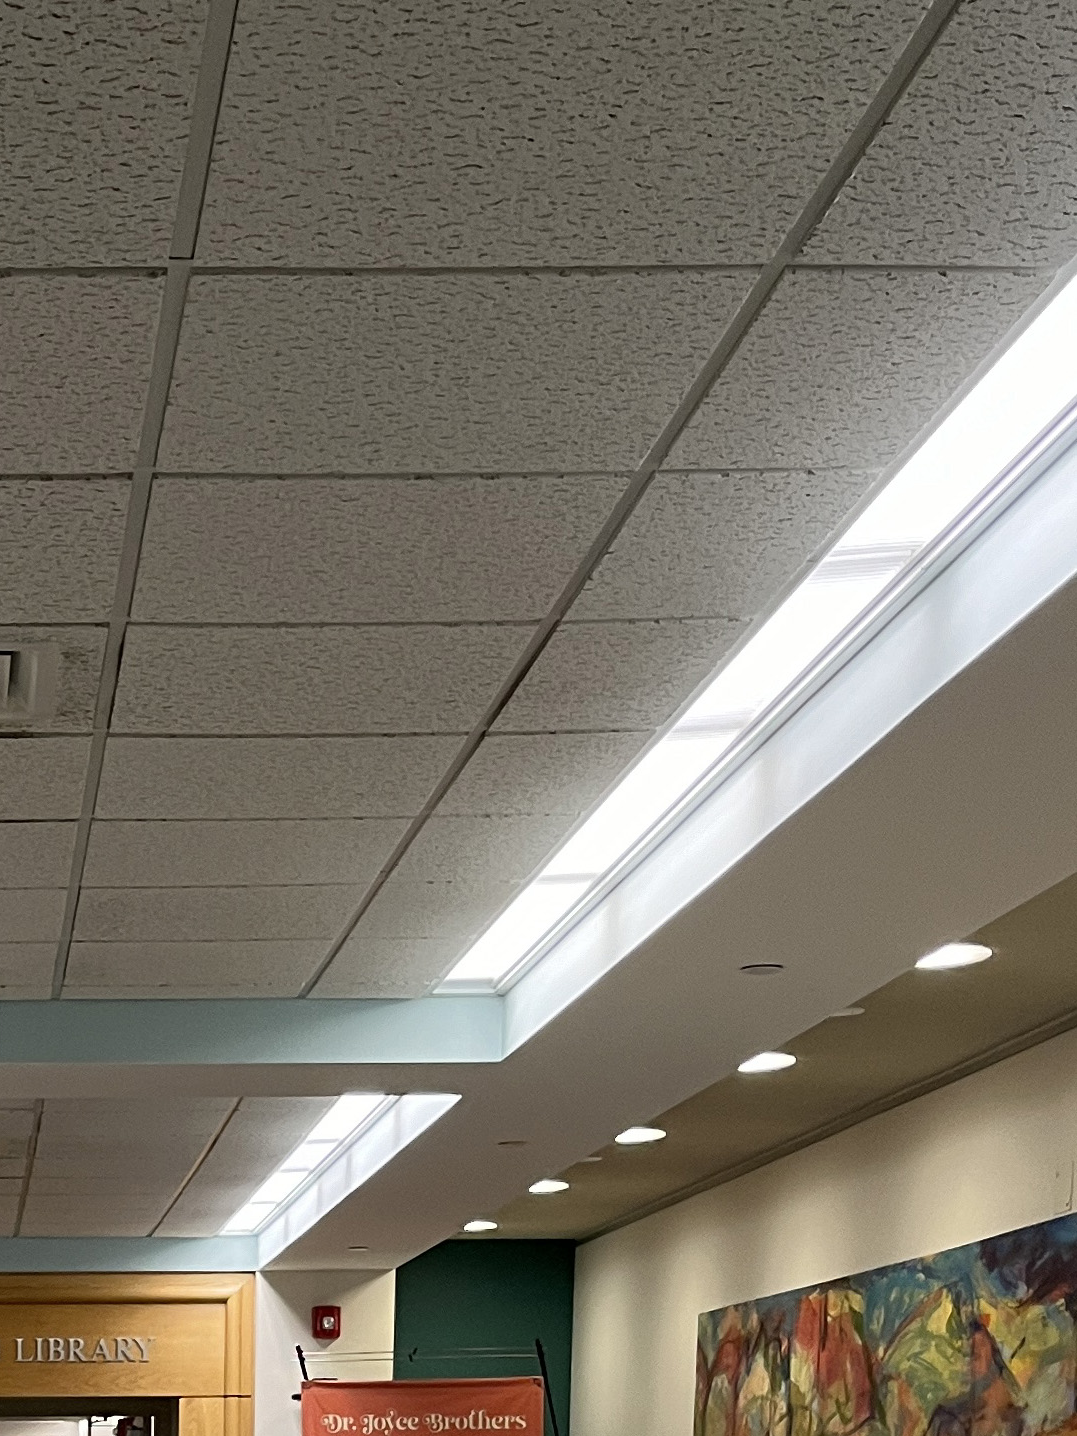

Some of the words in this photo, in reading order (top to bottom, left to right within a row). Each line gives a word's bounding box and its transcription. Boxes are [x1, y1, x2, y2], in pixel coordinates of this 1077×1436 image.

[14, 1337, 156, 1363] LIBRARY
[322, 1413, 357, 1433] Dr.
[360, 1409, 419, 1435] Joyce
[423, 1410, 527, 1433] Brothers
